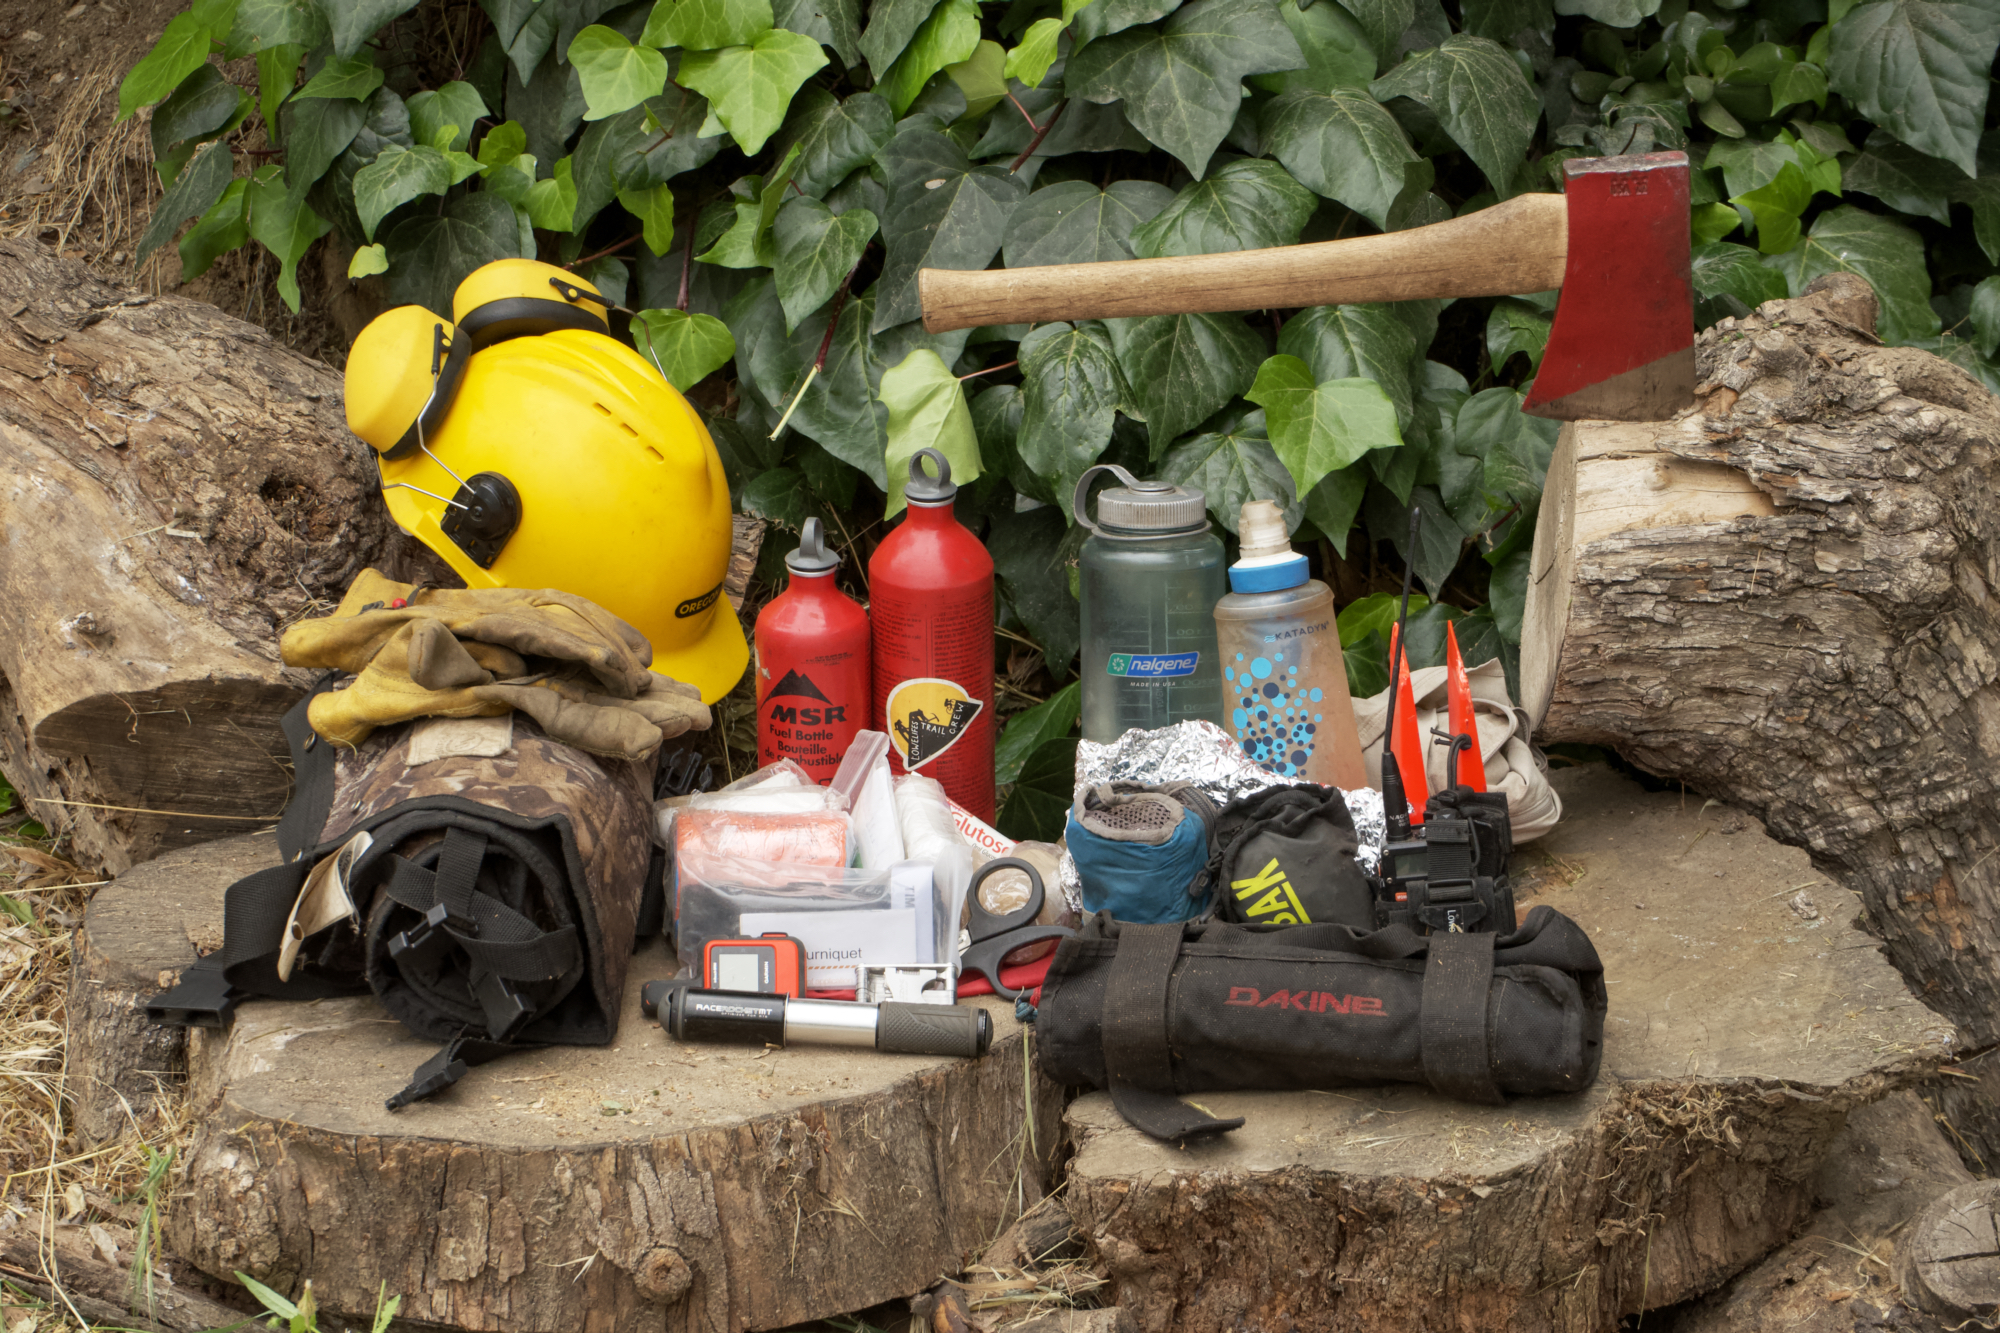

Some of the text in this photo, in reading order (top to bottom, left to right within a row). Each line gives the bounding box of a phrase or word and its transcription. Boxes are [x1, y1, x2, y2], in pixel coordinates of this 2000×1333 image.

[1275, 622, 1327, 640] KATADYN
[1131, 657, 1195, 675] nalgene
[770, 704, 847, 726] MSR
[769, 723, 834, 741] Fuel Bottle
[921, 722, 946, 735] TRAIL
[765, 746, 775, 759] de
[778, 740, 827, 755] Bouteille
[806, 948, 862, 961] urniquet
[1223, 986, 1388, 1017] DAKINE
